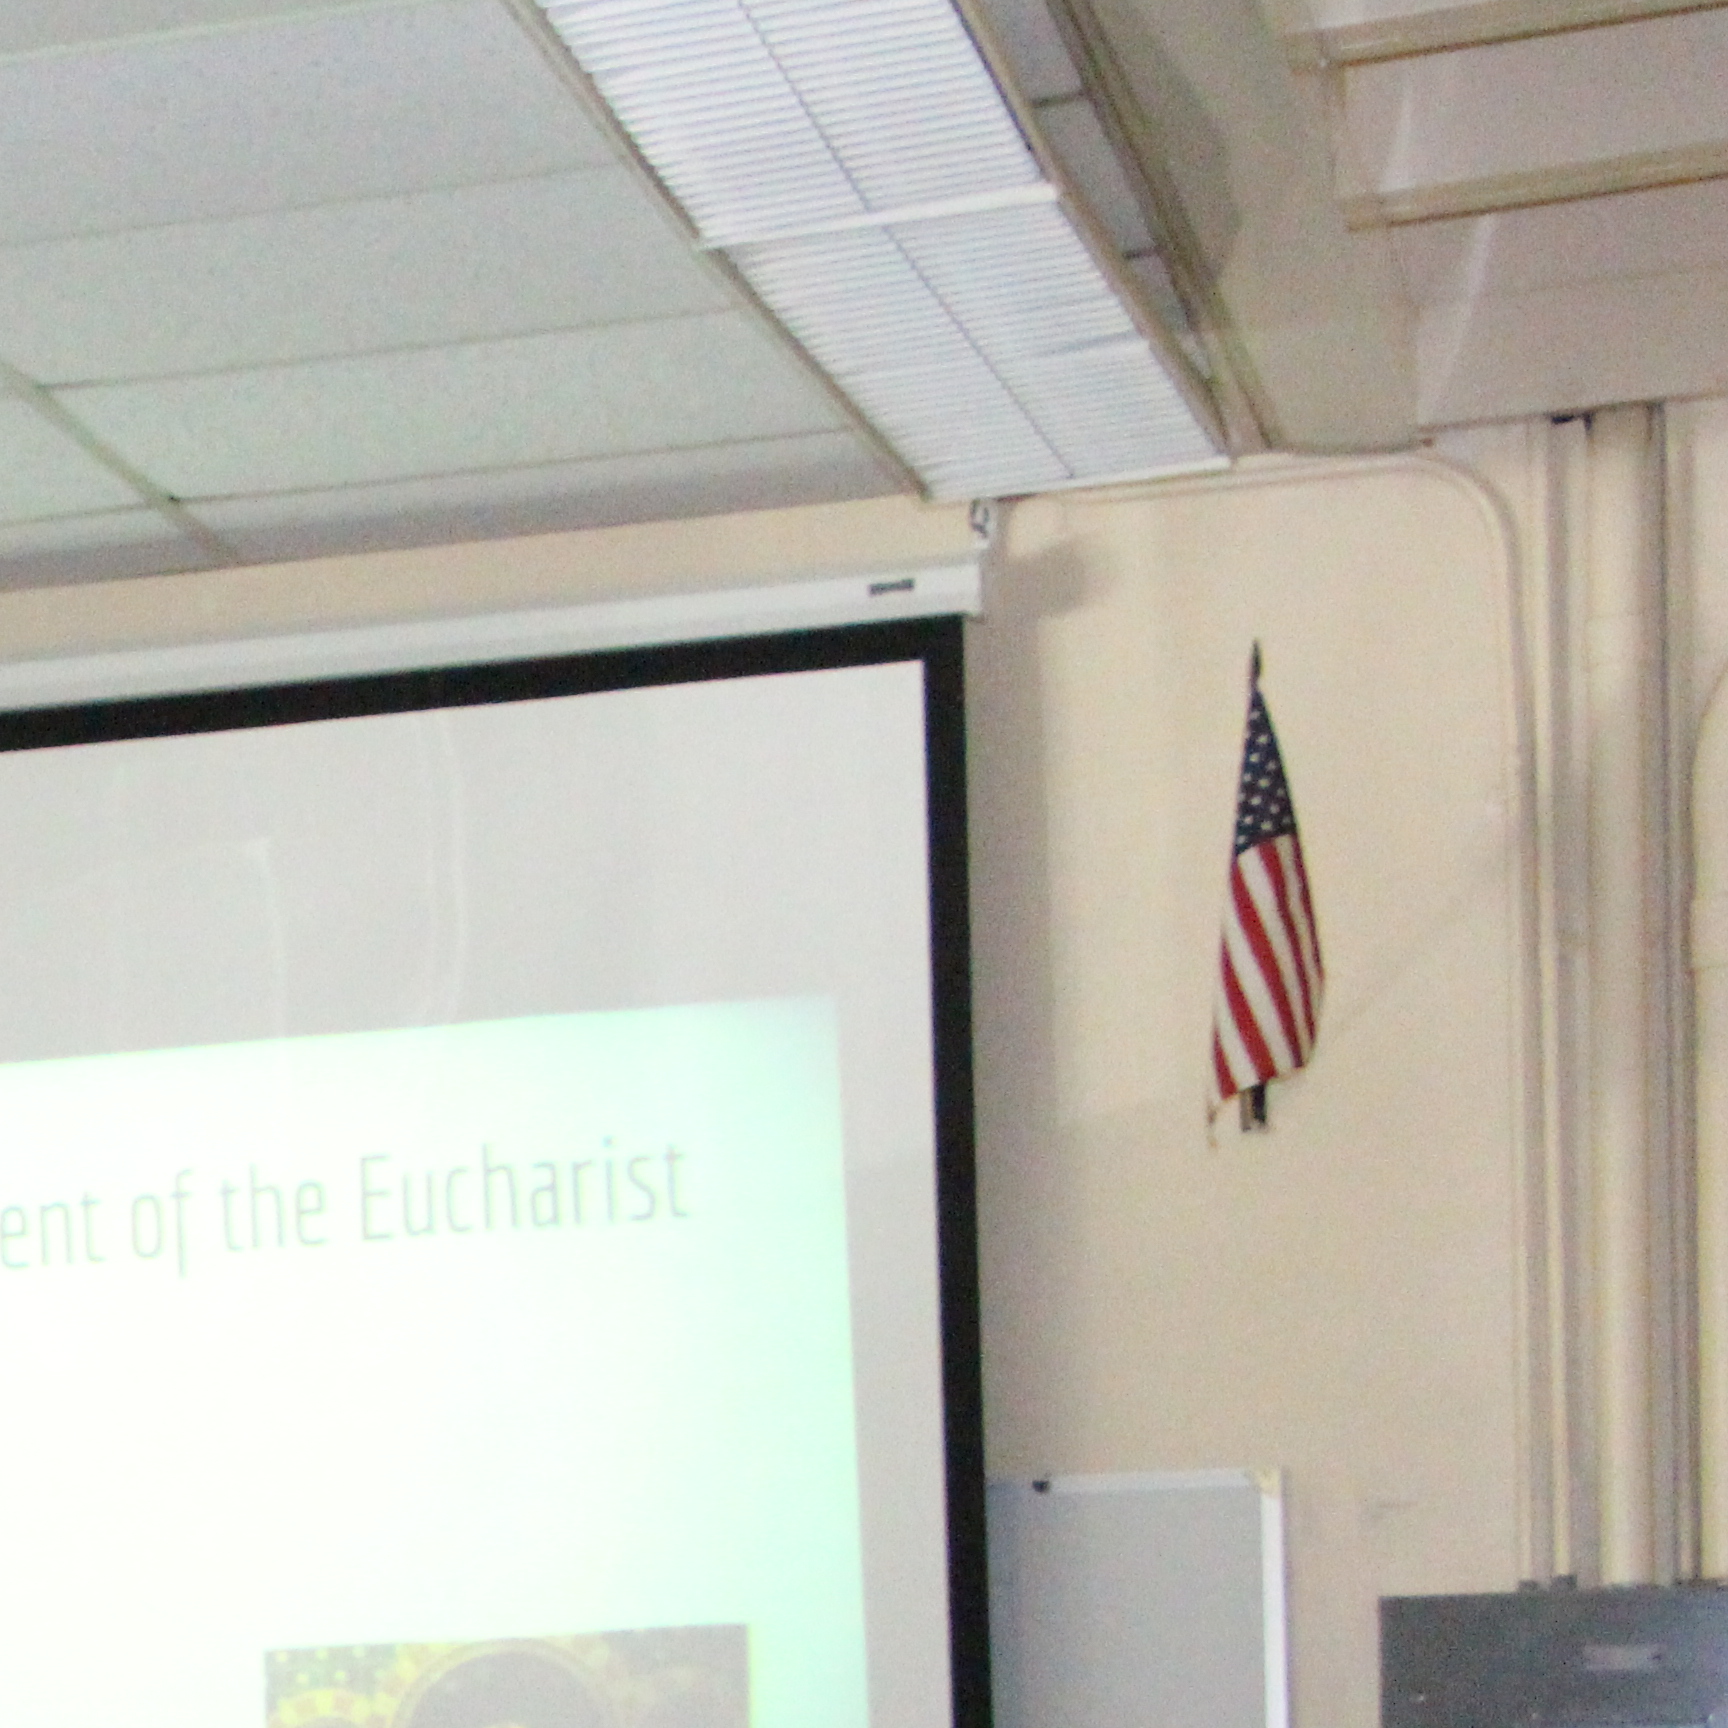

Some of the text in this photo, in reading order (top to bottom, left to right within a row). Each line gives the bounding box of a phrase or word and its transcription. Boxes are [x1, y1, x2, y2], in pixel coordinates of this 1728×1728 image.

[129, 1167, 196, 1278] of
[219, 1162, 330, 1255] the
[357, 1135, 693, 1244] Eucharist
